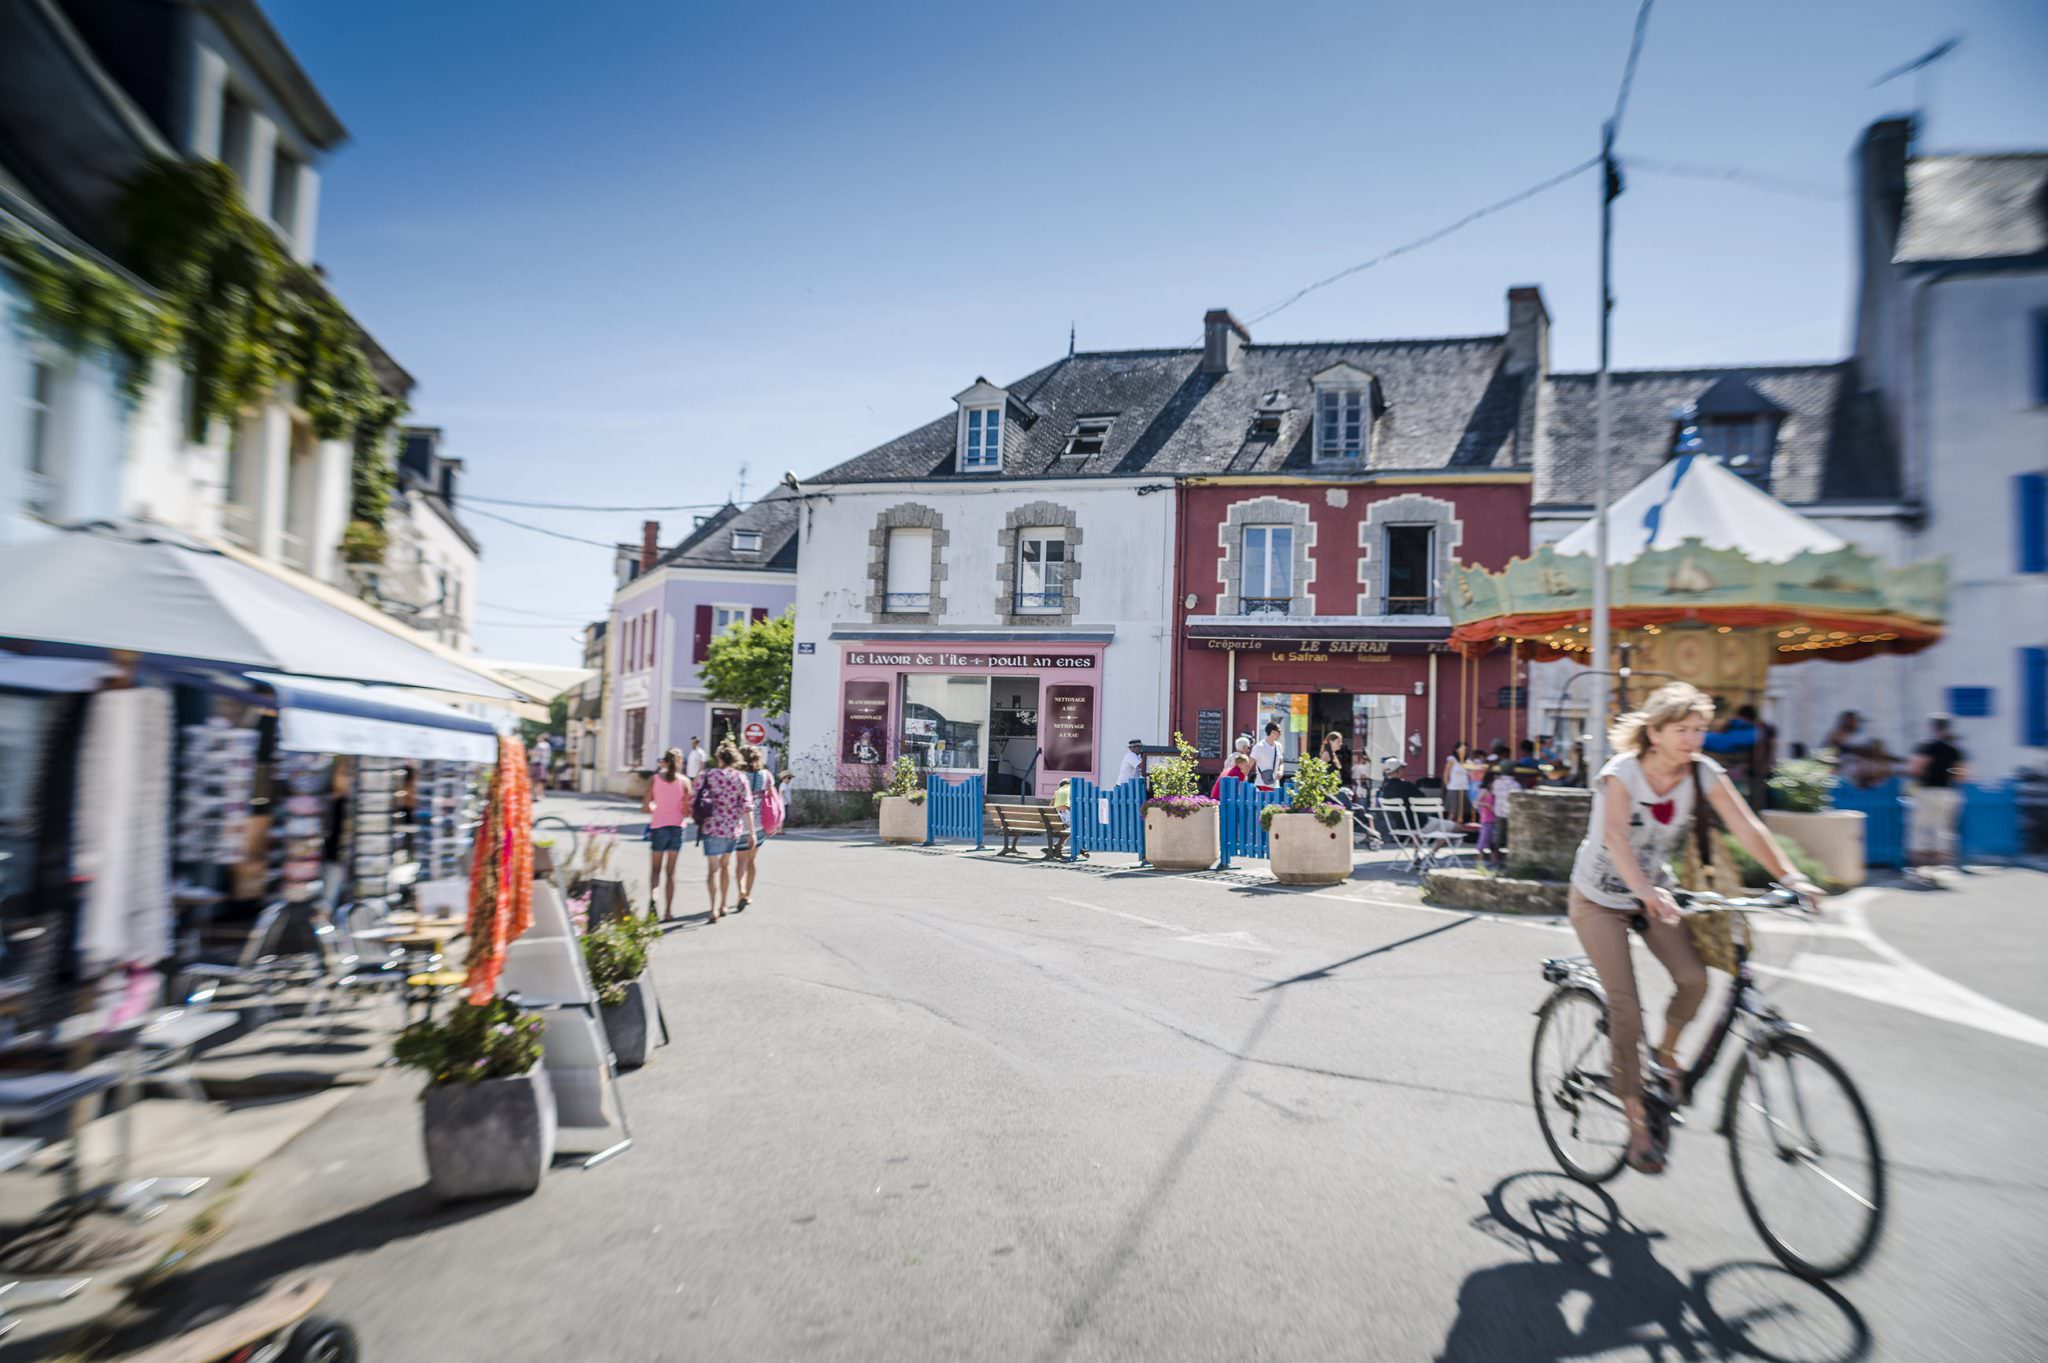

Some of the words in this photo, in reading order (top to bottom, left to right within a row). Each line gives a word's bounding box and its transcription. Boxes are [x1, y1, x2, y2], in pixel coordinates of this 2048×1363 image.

[1299, 640, 1321, 652] LE
[1328, 641, 1389, 653] SAFRAN
[916, 654, 934, 665] de
[1033, 657, 1051, 667] an
[1271, 651, 1285, 662] Le
[1288, 652, 1329, 663] Safran
